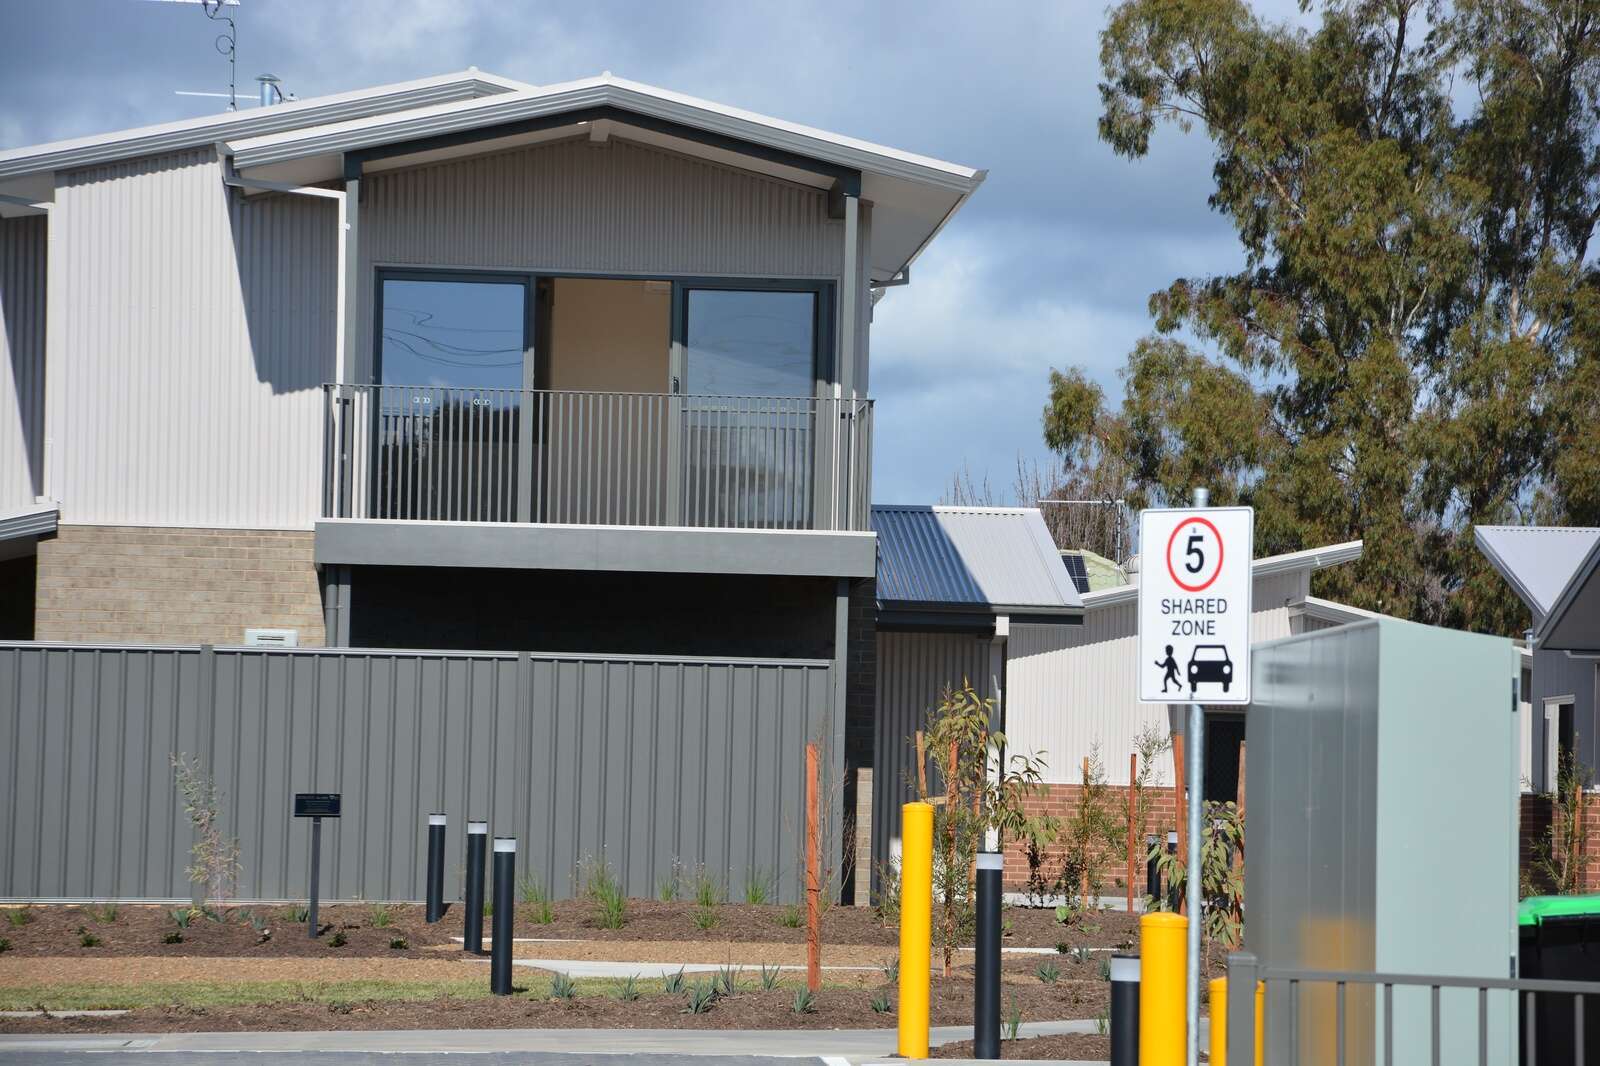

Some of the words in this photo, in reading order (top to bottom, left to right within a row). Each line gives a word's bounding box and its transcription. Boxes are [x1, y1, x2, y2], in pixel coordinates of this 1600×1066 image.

[1185, 535, 1204, 573] 5
[1161, 598, 1228, 615] SHARED
[1171, 620, 1216, 636] ZONE
